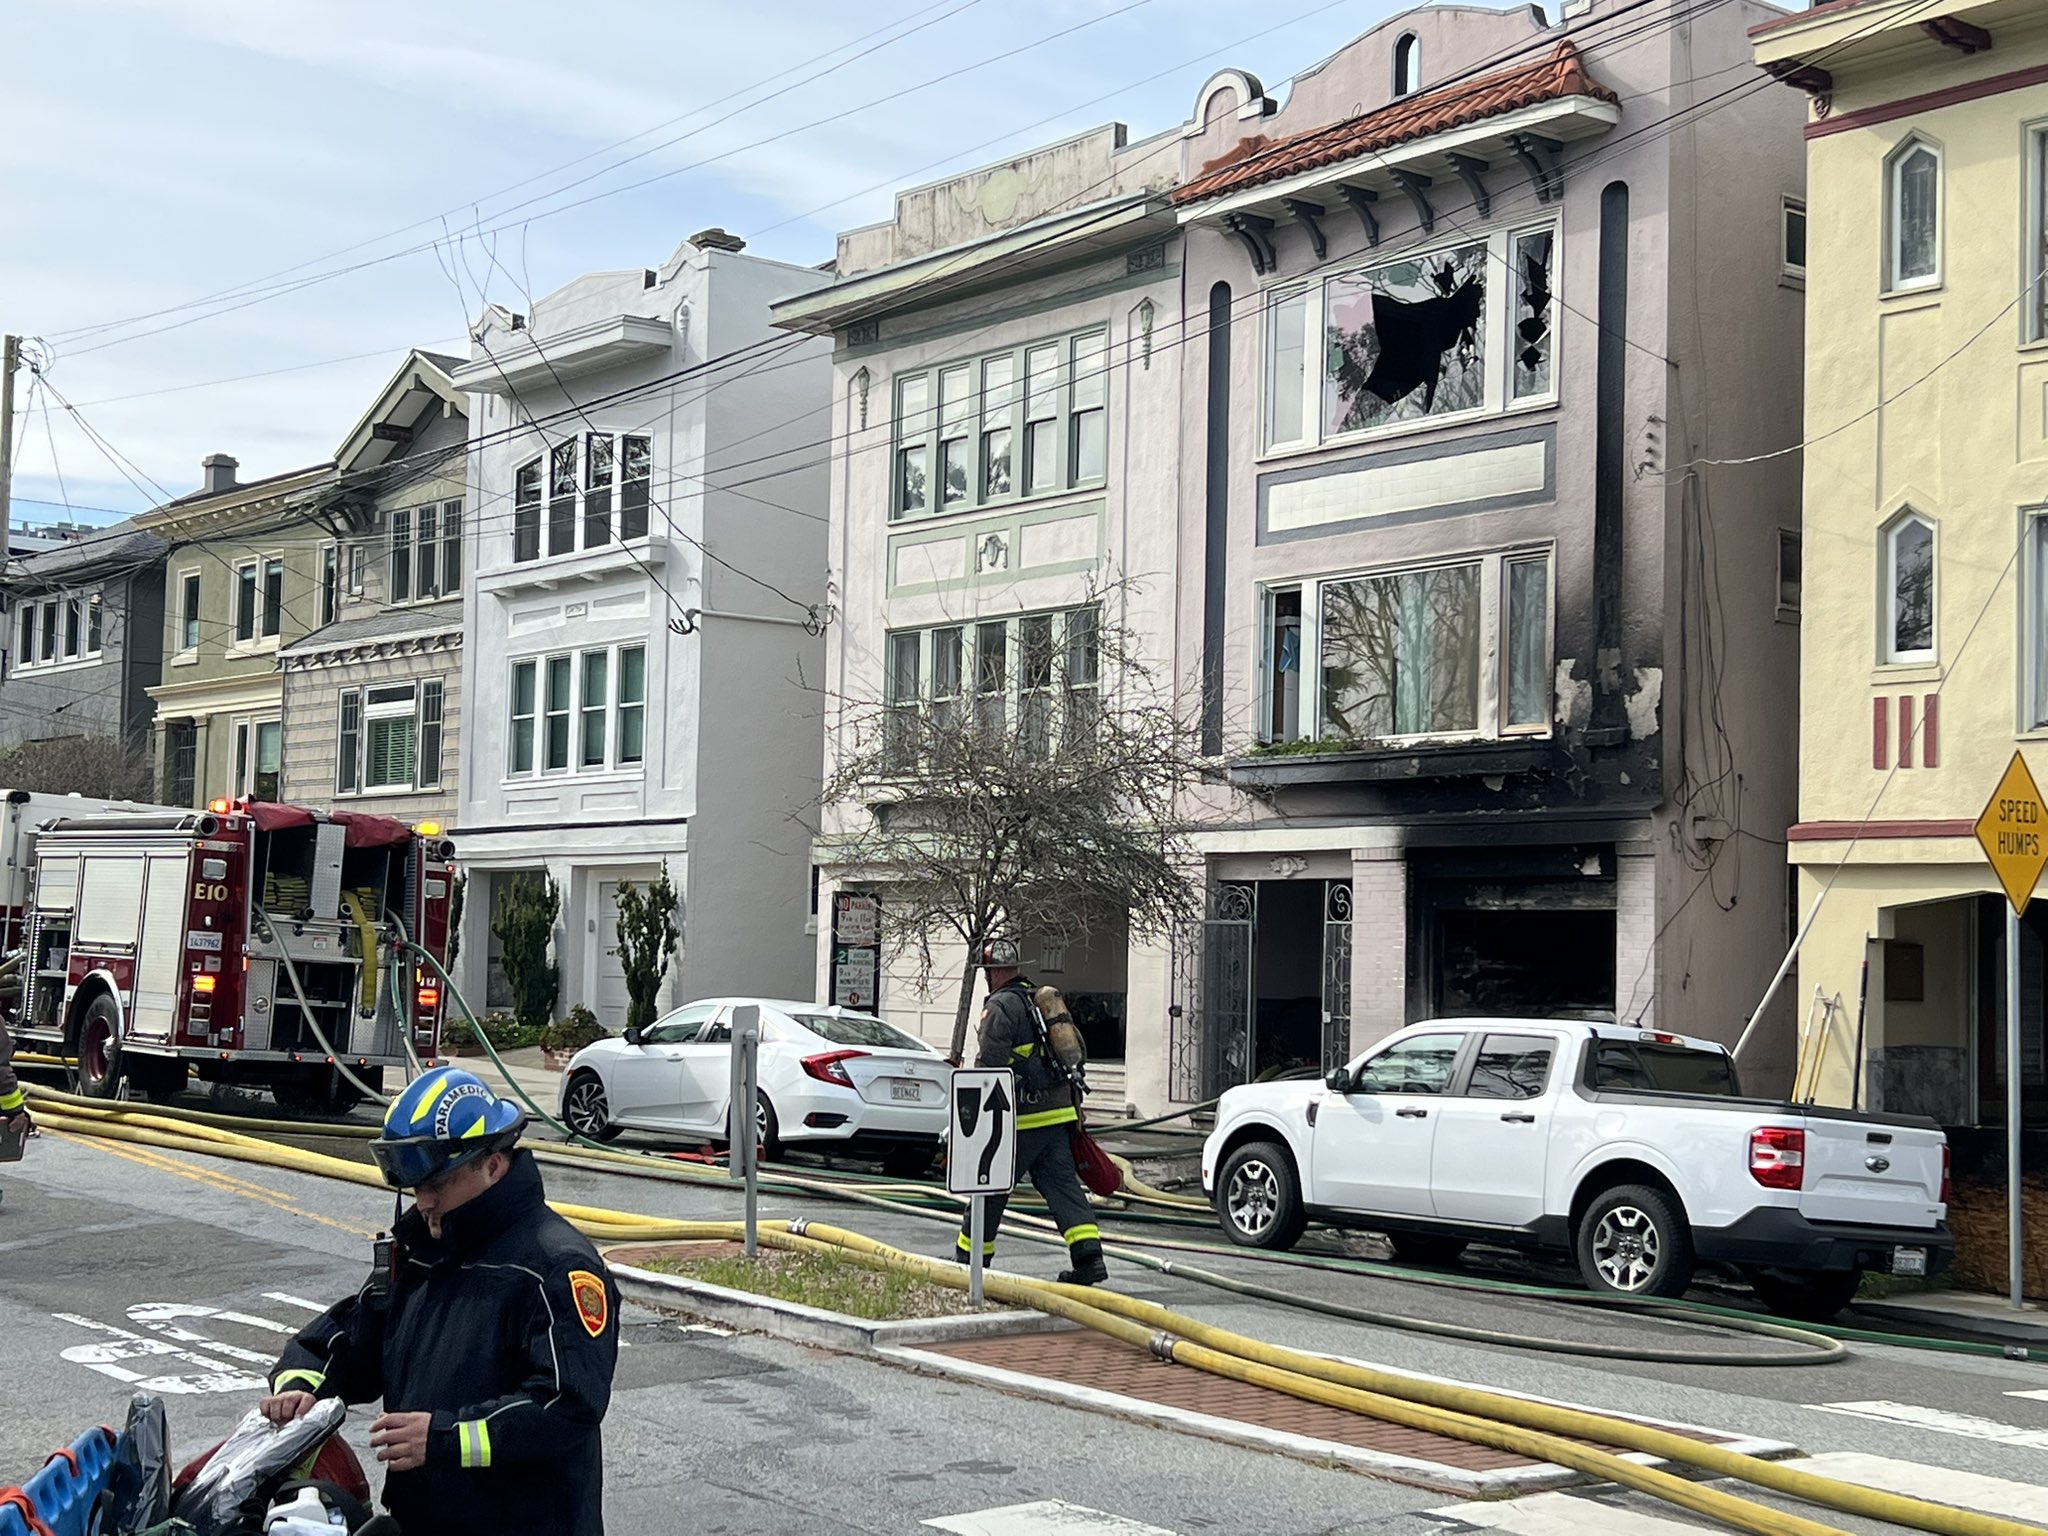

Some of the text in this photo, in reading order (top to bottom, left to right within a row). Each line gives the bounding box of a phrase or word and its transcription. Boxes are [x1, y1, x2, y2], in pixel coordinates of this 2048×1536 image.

[1999, 799, 2038, 824] SPEED
[1998, 832, 2039, 856] HUMPS
[194, 883, 229, 901] E10
[437, 1085, 487, 1136] PARAMEDIC
